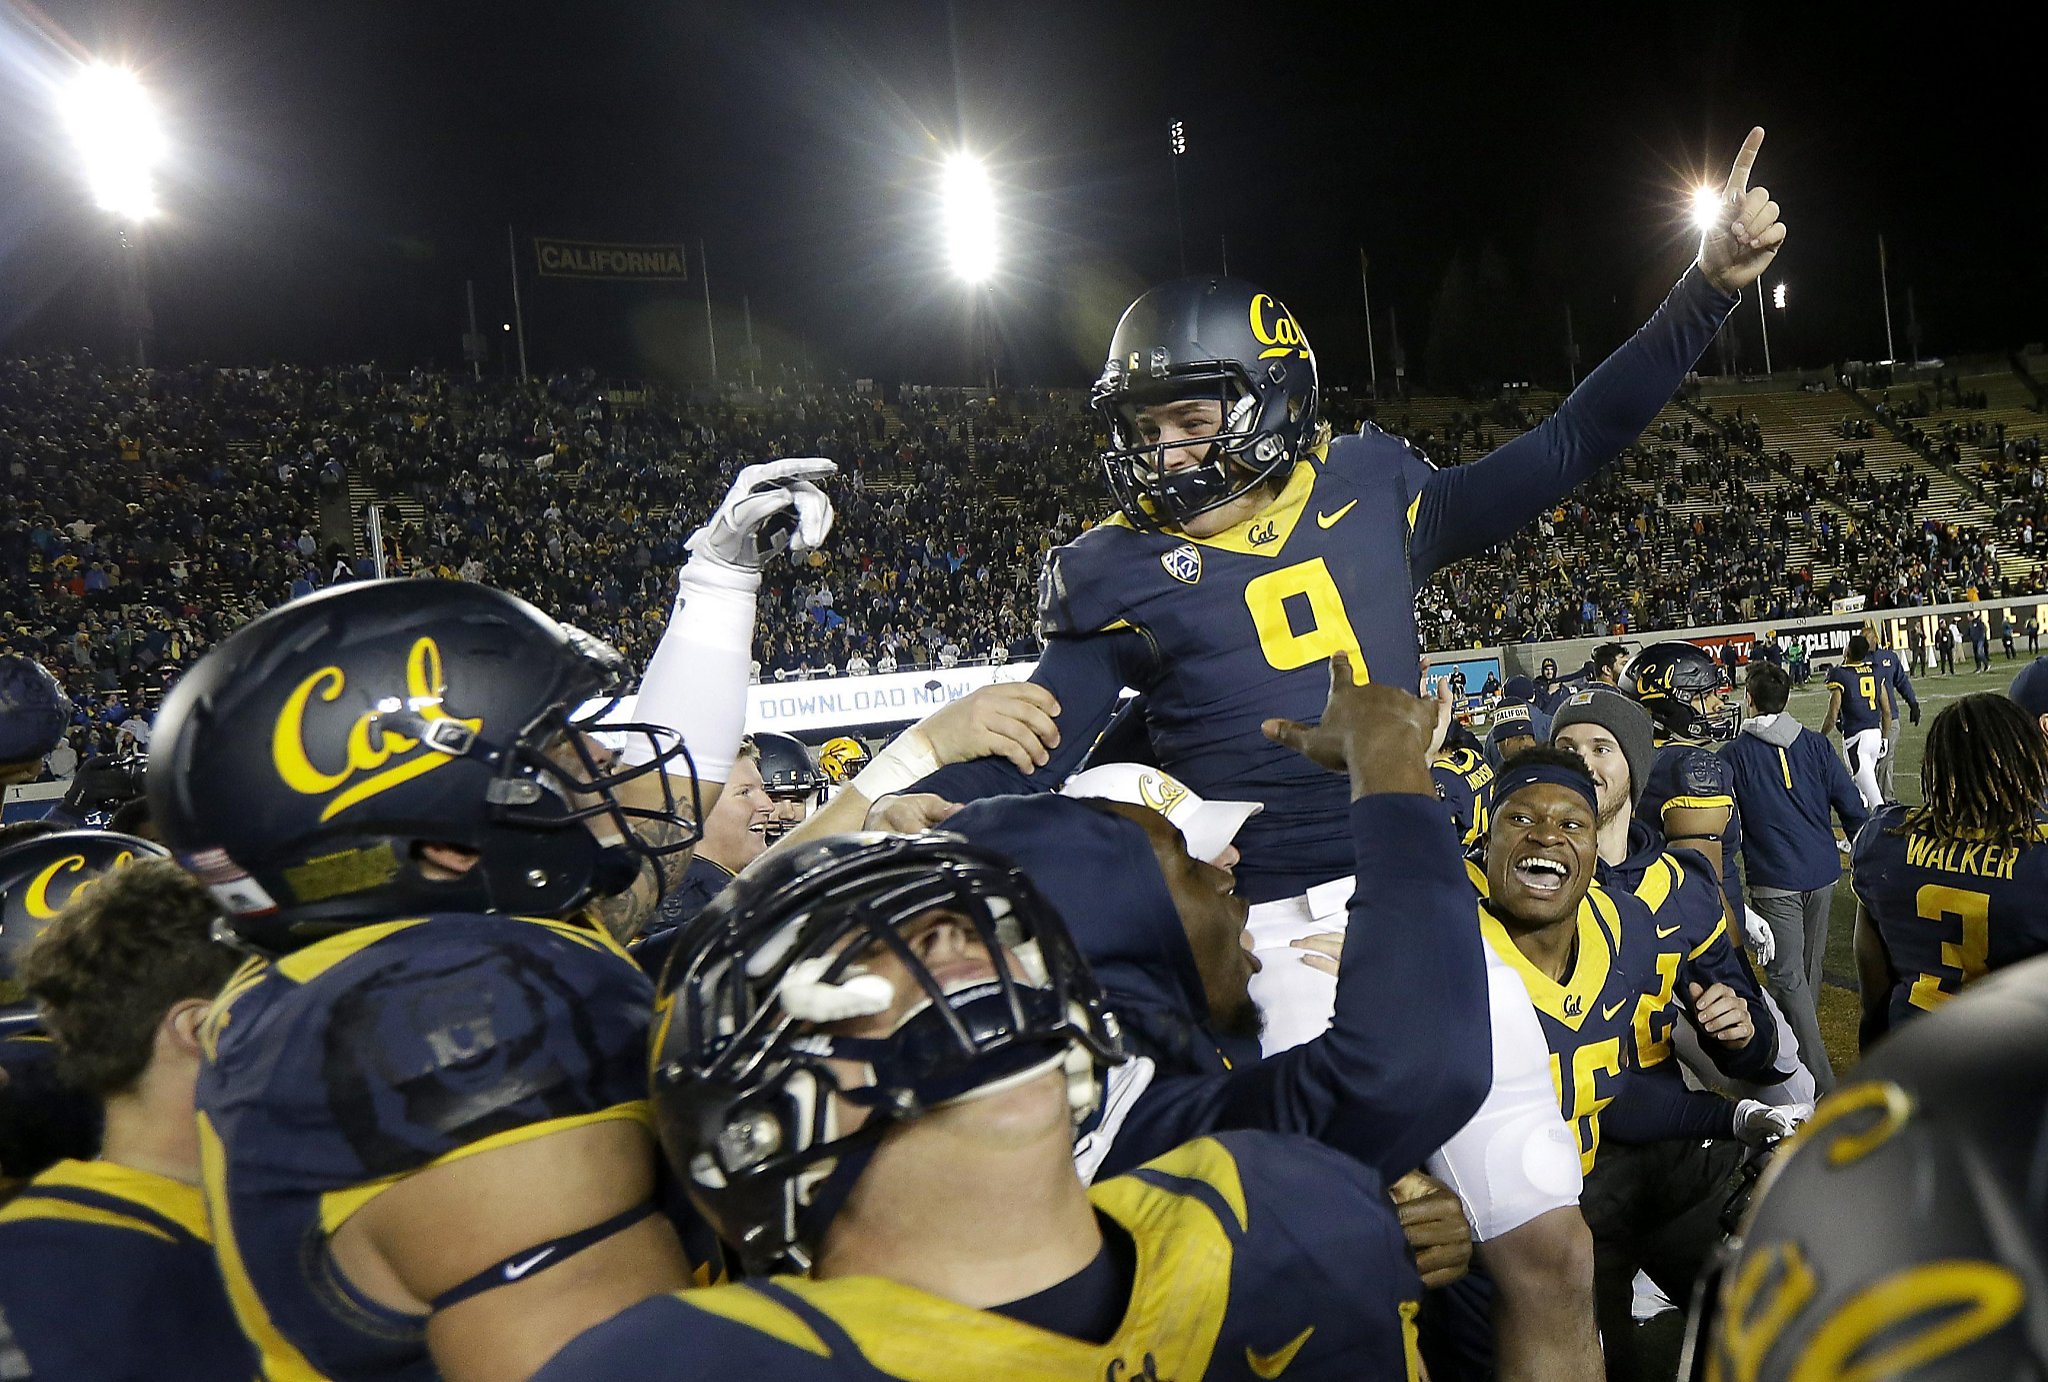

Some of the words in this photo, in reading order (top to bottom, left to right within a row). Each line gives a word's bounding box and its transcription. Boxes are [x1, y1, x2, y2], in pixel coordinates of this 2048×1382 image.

[541, 246, 682, 273] CALIFORNIA
[1249, 293, 1309, 360] Cal
[1248, 520, 1279, 547] Cal
[1244, 556, 1370, 687] 9
[1698, 641, 1752, 660] OYTA
[1637, 664, 1675, 700] Cal
[1859, 676, 1876, 710] 9
[760, 687, 905, 719] DOWNLOAD
[273, 636, 484, 823] Cal
[1139, 769, 1188, 817] Cal
[1906, 833, 2019, 880] WALKER
[1908, 883, 1990, 1012] 3
[1563, 994, 1583, 1019] Cal
